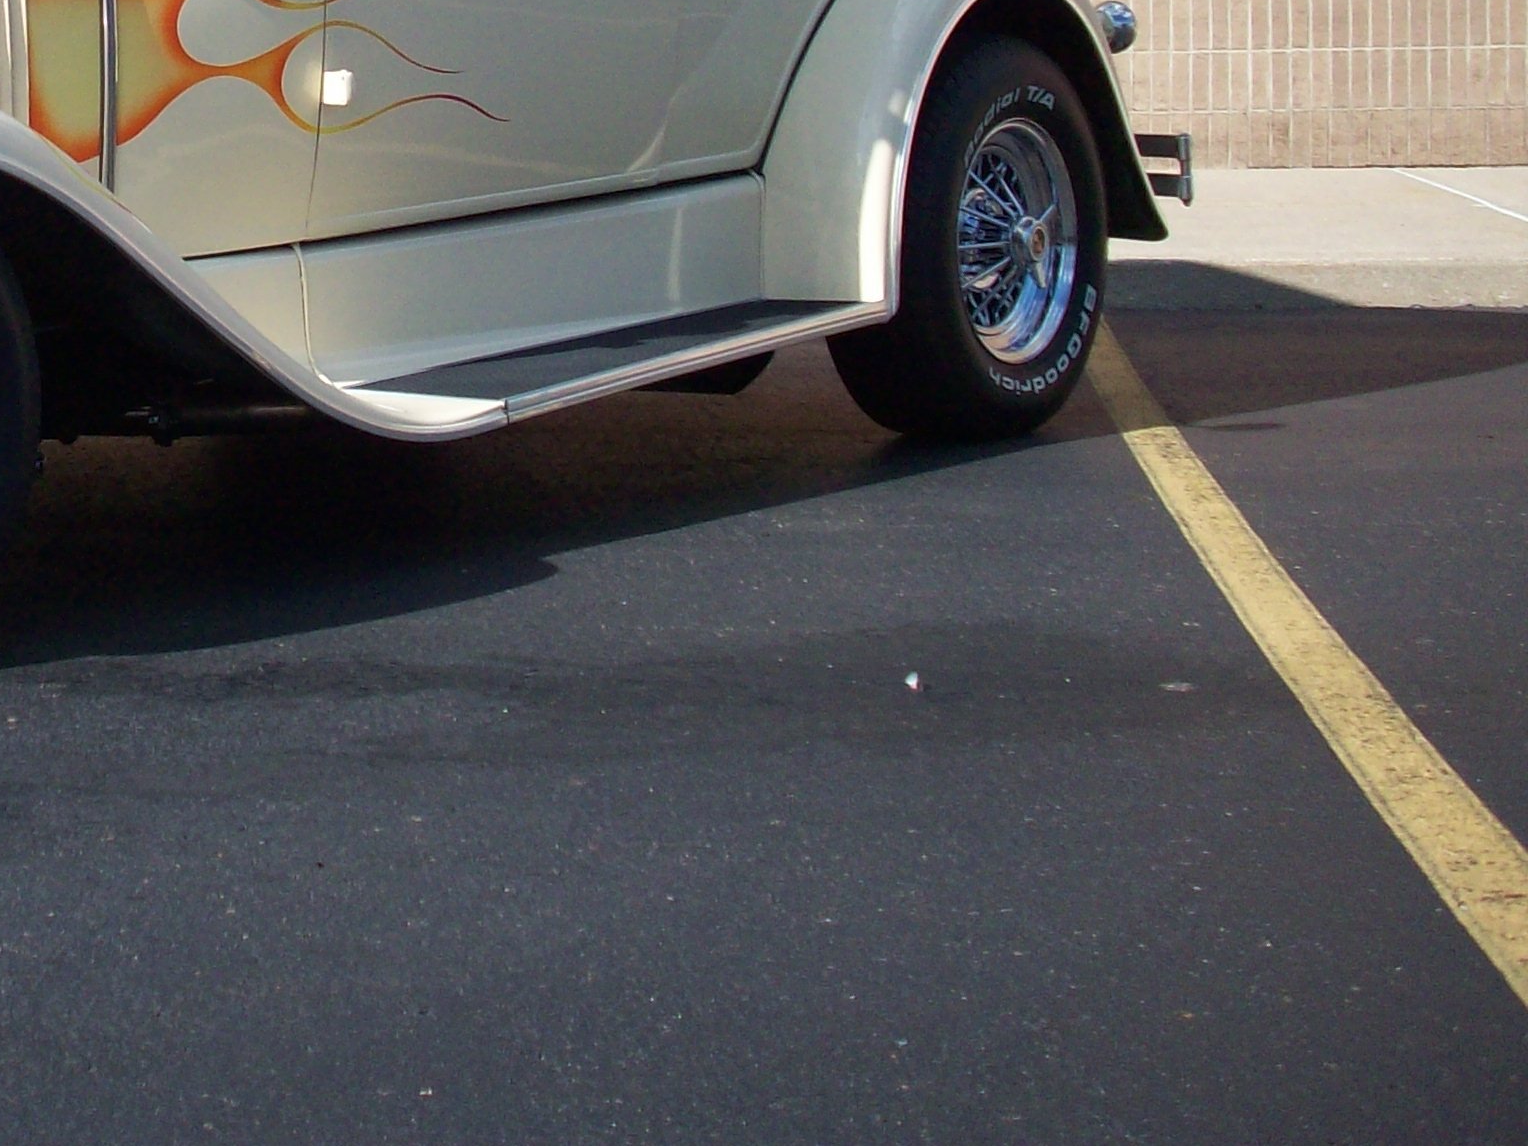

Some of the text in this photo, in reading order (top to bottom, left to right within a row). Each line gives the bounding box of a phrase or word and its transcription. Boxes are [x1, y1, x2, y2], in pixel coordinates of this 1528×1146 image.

[963, 85, 1055, 168] Radial T/A
[989, 283, 1097, 395] BFGoodrich
